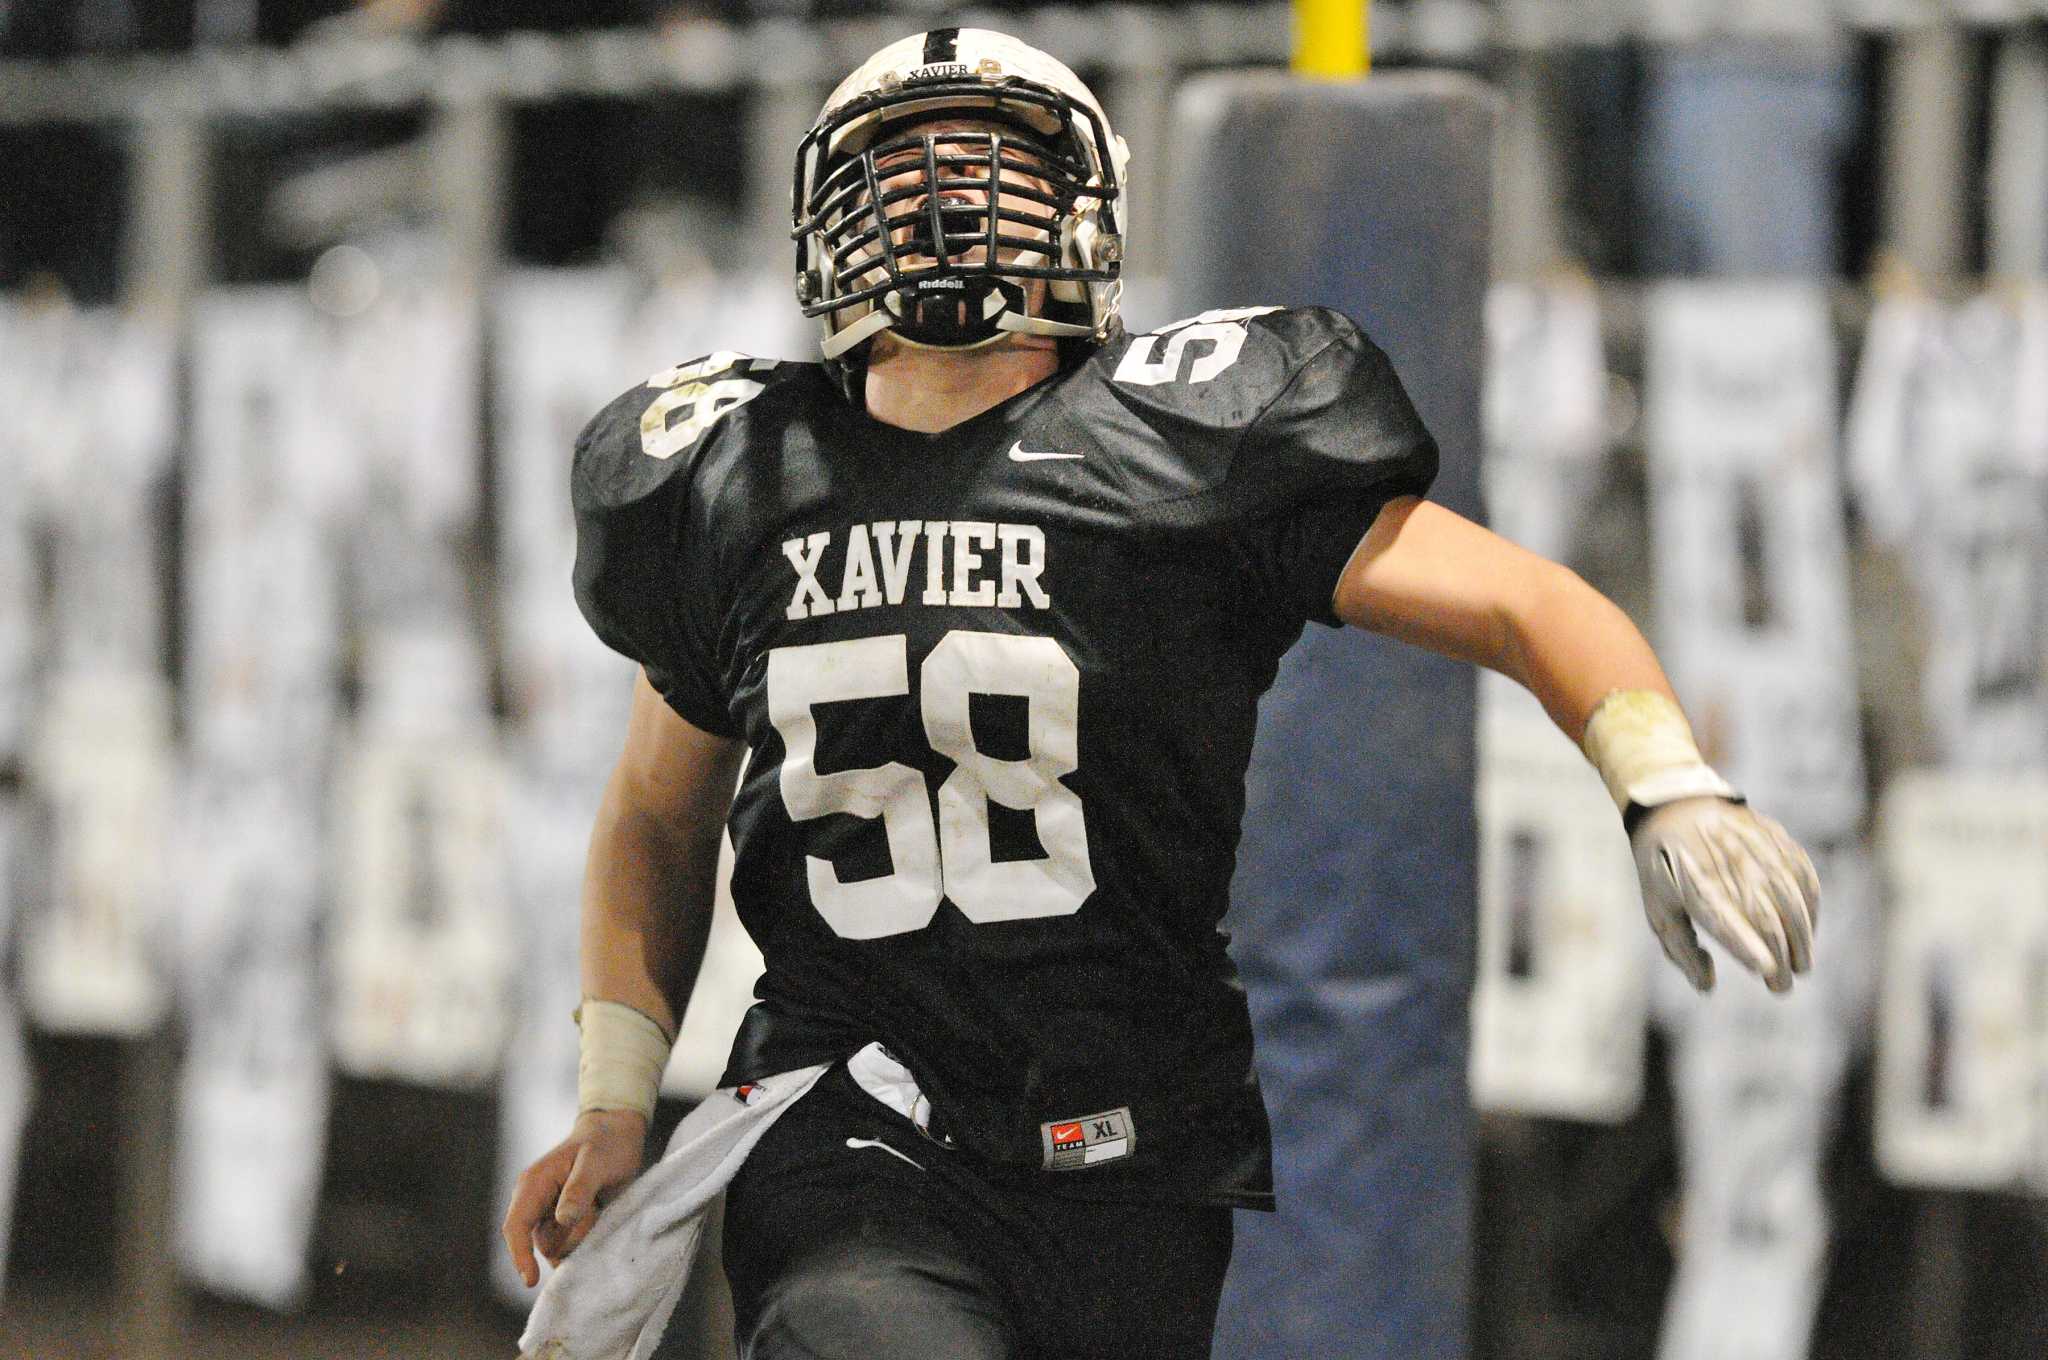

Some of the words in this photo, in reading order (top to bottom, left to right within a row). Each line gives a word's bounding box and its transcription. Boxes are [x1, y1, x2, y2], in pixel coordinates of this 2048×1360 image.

[908, 64, 969, 81] XAVIER
[782, 520, 1051, 621] XAVIER
[767, 630, 1098, 940] 58
[1092, 1120, 1118, 1139] XL
[1056, 1141, 1084, 1151] TEAM
